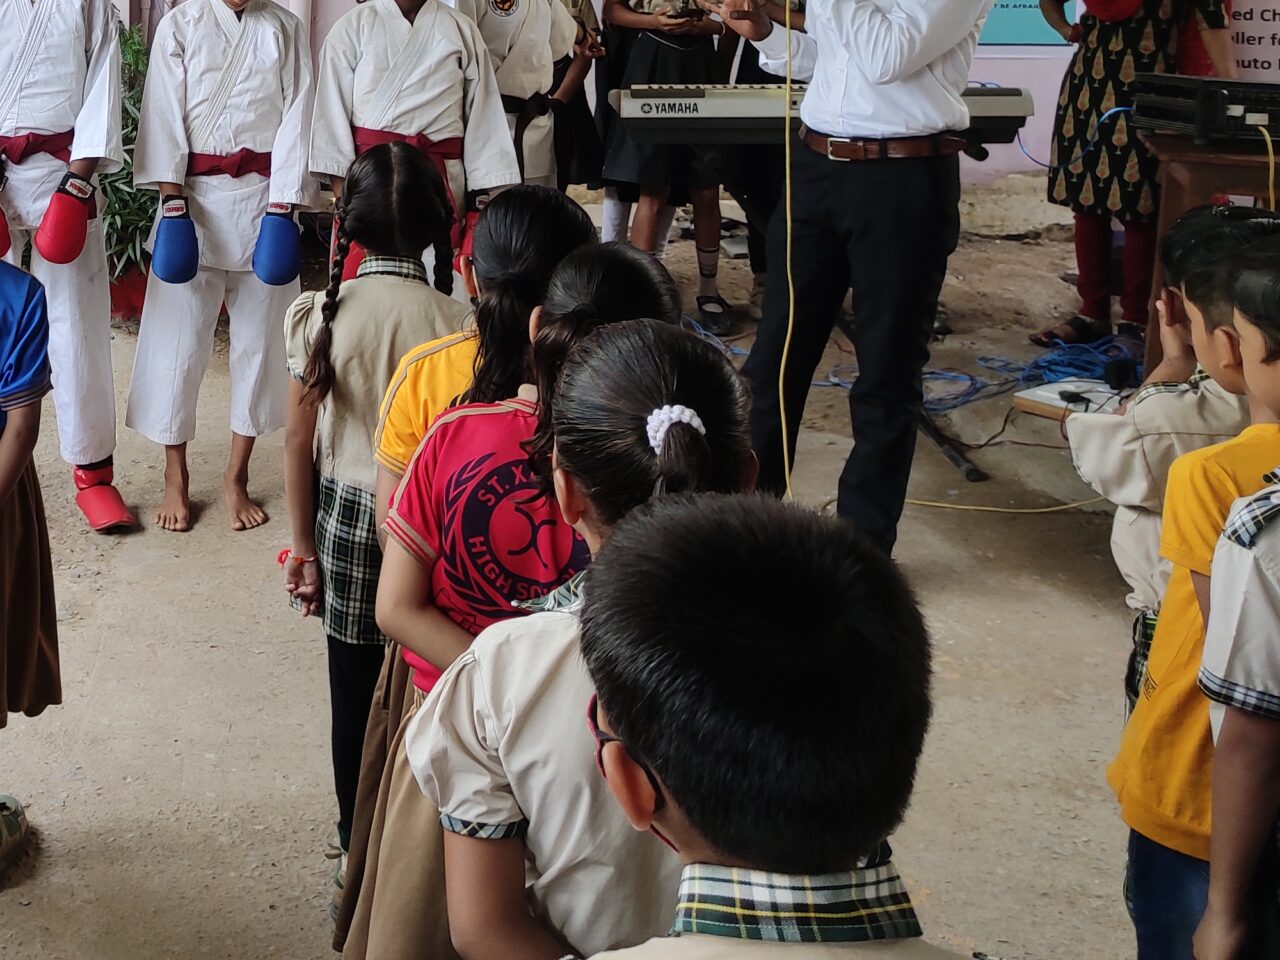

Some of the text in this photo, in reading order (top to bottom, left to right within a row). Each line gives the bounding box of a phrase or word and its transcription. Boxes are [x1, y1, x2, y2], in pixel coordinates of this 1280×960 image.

[1231, 32, 1264, 45] ller
[654, 102, 699, 115] YAMAHA
[477, 476, 510, 507] ST.
[468, 536, 509, 594] HIGH
